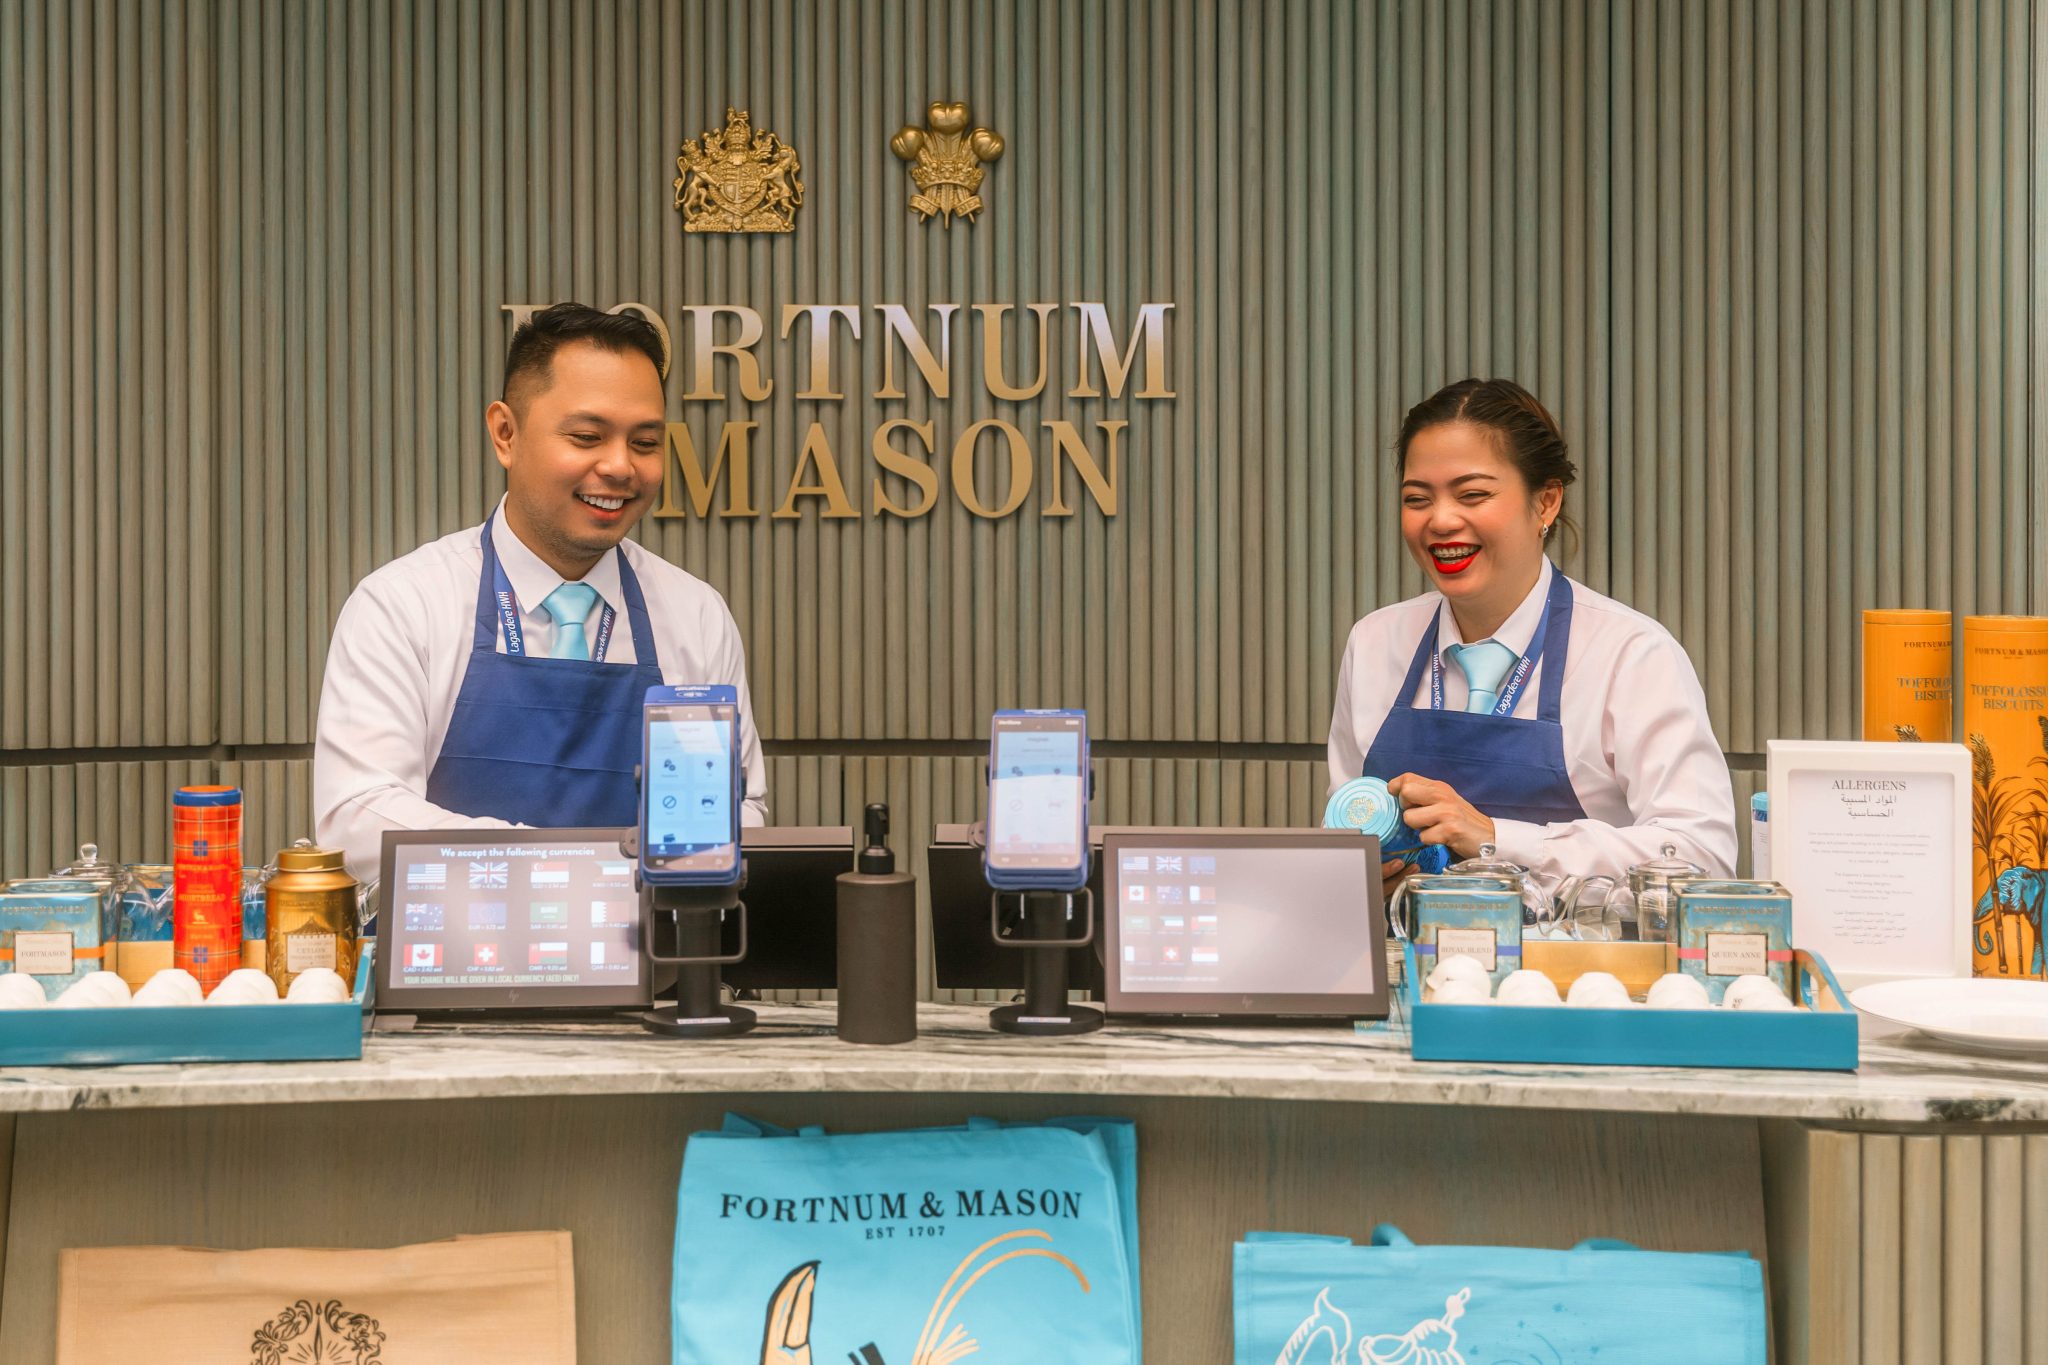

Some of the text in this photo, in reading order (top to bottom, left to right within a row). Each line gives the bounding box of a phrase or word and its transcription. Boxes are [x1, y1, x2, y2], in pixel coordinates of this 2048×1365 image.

[501, 302, 1176, 401] RTNUM
[653, 418, 1128, 519] MASON
[498, 591, 510, 610] HWH
[602, 606, 612, 628] HWH
[1517, 655, 1531, 678] HWH
[1983, 698, 2044, 711] BISCUITS
[1831, 779, 1907, 791] ALLERGENS
[1875, 795, 1897, 806] المواد
[440, 847, 596, 860] We accept the following currencies
[1711, 951, 1738, 959] QUEEN
[495, 975, 513, 984] LOCAL
[514, 975, 545, 983] CURRENCY
[719, 1189, 1083, 1223] FORTNUM & MASON
[865, 1225, 946, 1240] EST 1707
